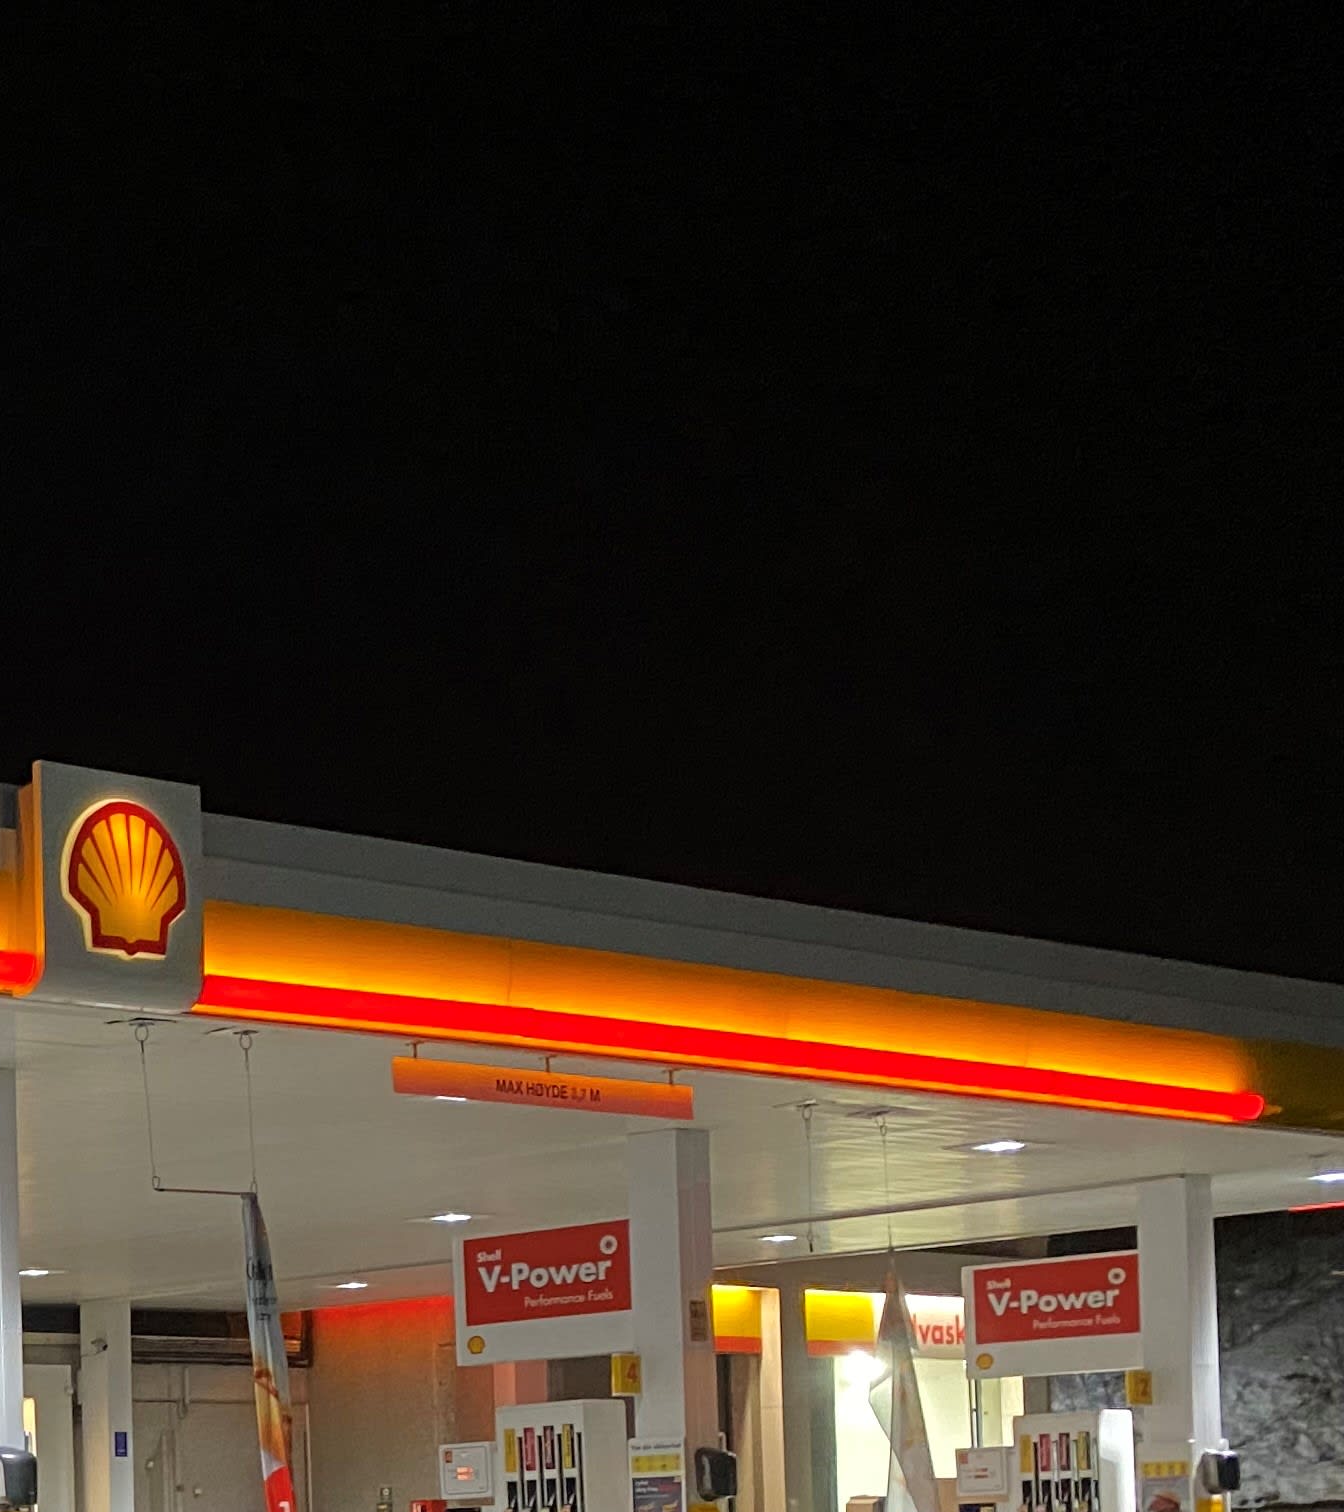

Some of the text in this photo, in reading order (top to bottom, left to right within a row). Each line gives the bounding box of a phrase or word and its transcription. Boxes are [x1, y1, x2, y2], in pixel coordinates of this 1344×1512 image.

[496, 1079, 524, 1096] MAX
[526, 1082, 568, 1100] HØYDE
[589, 1087, 601, 1102] M
[476, 1249, 502, 1263] Shell
[477, 1260, 612, 1293] V-Power
[986, 1278, 1011, 1291] Shell
[524, 1288, 614, 1309] Performance Fuels
[987, 1288, 1120, 1317] V-Power
[1032, 1314, 1121, 1330] Performance Fuels
[626, 1362, 638, 1384] 4
